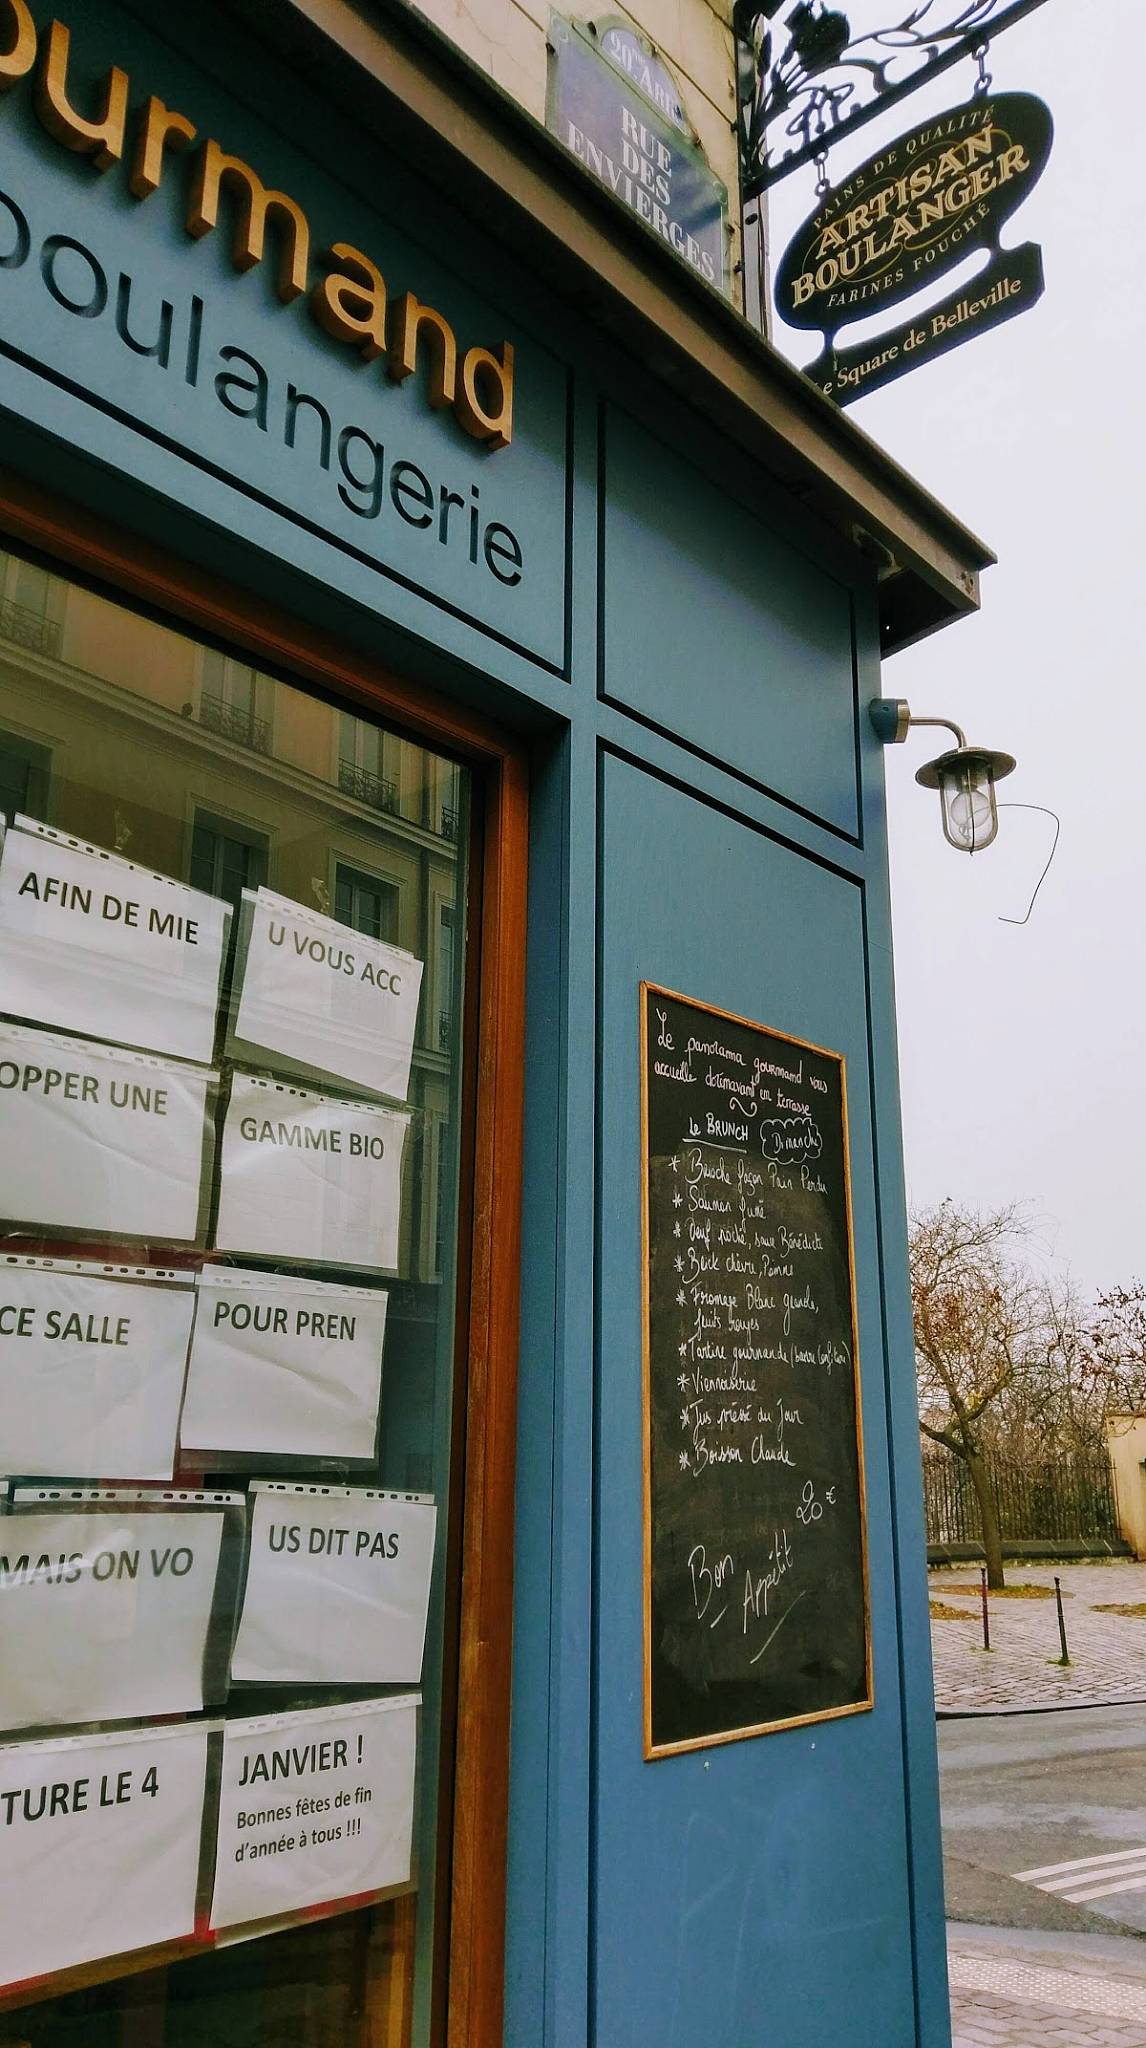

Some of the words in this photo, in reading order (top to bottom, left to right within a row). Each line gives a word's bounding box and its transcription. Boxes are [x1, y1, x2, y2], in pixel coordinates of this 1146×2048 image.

[621, 105, 672, 178] RUE
[813, 175, 865, 229] PAINS
[873, 152, 897, 176] DE
[905, 104, 995, 155] QUALITÉ
[622, 139, 671, 206] DES
[814, 123, 995, 260] ARTISAN
[567, 119, 715, 282] ENVIERGES
[790, 144, 1031, 309] BOULANGER
[826, 271, 905, 308] FARINES
[912, 201, 991, 273] FOUCHÉ
[836, 345, 899, 388] Square
[903, 328, 926, 351] de
[931, 277, 1022, 337] Belleville
[18, 871, 91, 914] AFIN
[102, 894, 138, 928] DE
[148, 909, 199, 945] MIE
[268, 921, 286, 947] U
[293, 930, 355, 977] VOUS
[360, 964, 402, 997] ACC
[656, 1007, 675, 1051] Le
[684, 1037, 747, 1066] panorama
[753, 1057, 803, 1084] gourmand
[809, 1076, 828, 1094] vous
[0, 1059, 99, 1104] OPPER
[110, 1079, 168, 1116] UNE
[654, 1060, 697, 1083] accueille
[759, 1087, 772, 1101] en
[776, 1088, 812, 1117] terrasse
[239, 1116, 342, 1154] GAMME
[349, 1133, 385, 1161] BIO
[705, 1112, 749, 1141] BRUNCH
[771, 1127, 819, 1154] Dimanche
[684, 1147, 732, 1185] Brioche
[767, 1162, 793, 1191] Pain
[688, 1185, 732, 1213] Saumon
[213, 1301, 288, 1335] POUR
[295, 1310, 357, 1342] PREN
[745, 1283, 776, 1311] Blanc
[0, 1306, 36, 1337] CE
[44, 1309, 131, 1346] SALLE
[687, 1334, 727, 1362] Tartine
[689, 1399, 712, 1446] Jus
[757, 1406, 773, 1423] du
[692, 1437, 743, 1477] Boisson
[0, 1553, 83, 1586] MAIS
[92, 1549, 140, 1581] ON
[150, 1547, 194, 1577] VO
[268, 1524, 300, 1555] US
[308, 1528, 349, 1557] DIT
[355, 1530, 400, 1559] PAS
[687, 1544, 734, 1620] Bon
[238, 1738, 348, 1787] JANVIER
[356, 1734, 364, 1763] !
[1, 1777, 90, 1825] TURE
[99, 1770, 132, 1807] LE
[141, 1765, 159, 1798] 4
[236, 1804, 292, 1829] Bonnes
[295, 1797, 331, 1819] fêtes
[334, 1791, 352, 1810] de
[354, 1785, 373, 1804] fin
[298, 1829, 308, 1848] à
[311, 1823, 342, 1845] tous
[346, 1817, 362, 1837] !!!
